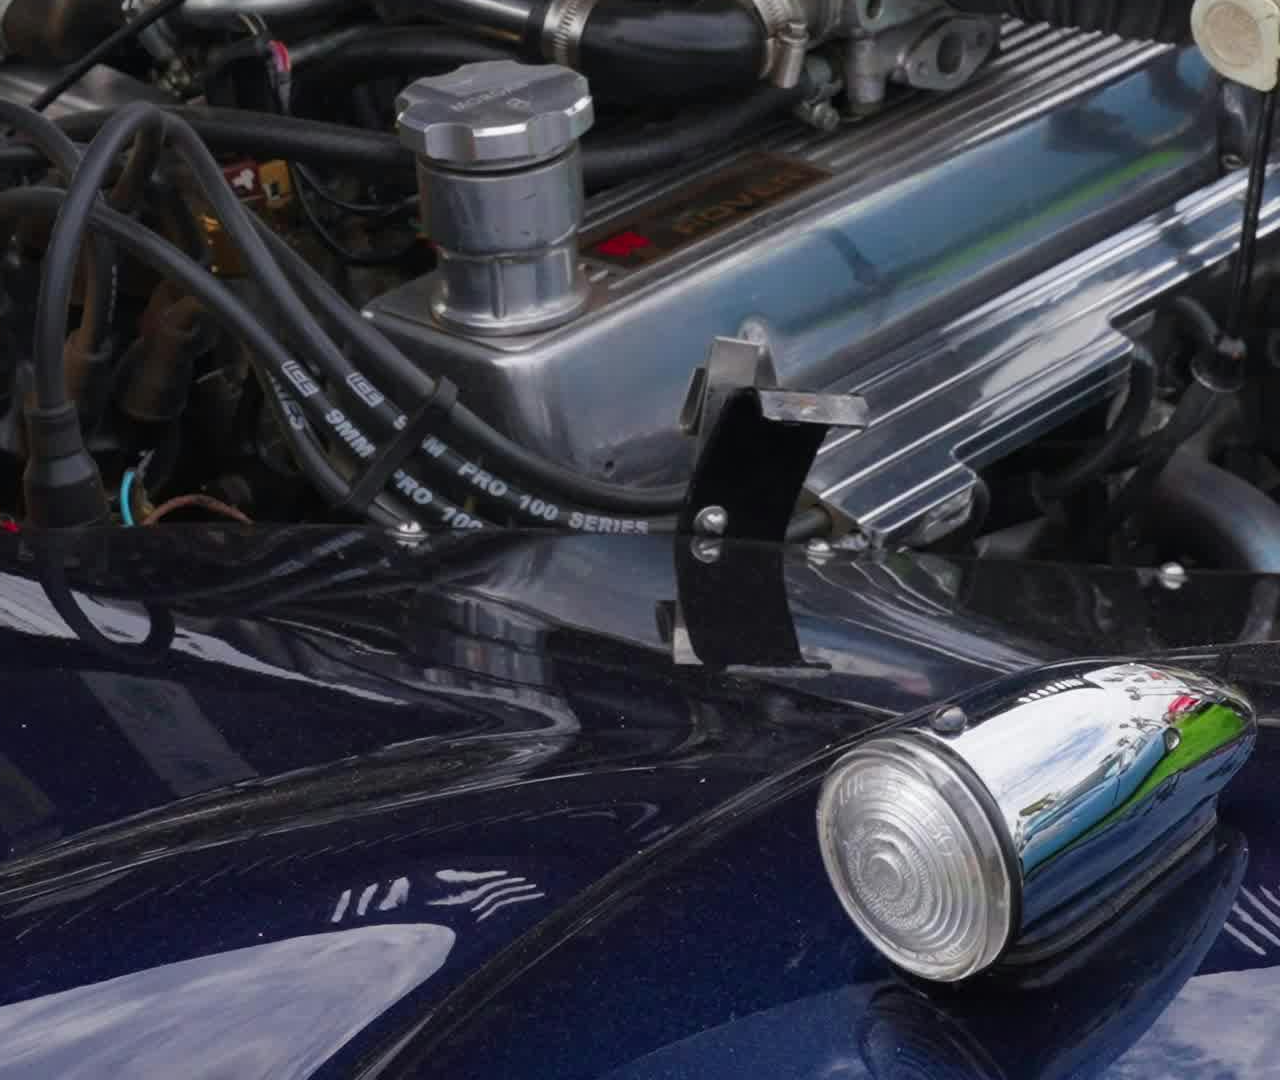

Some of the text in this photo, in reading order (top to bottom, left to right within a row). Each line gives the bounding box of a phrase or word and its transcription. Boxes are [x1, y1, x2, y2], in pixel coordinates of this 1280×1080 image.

[325, 408, 377, 459] 9MM
[457, 461, 508, 497] PRO
[520, 493, 560, 521] 100
[567, 511, 649, 535] SERIES
